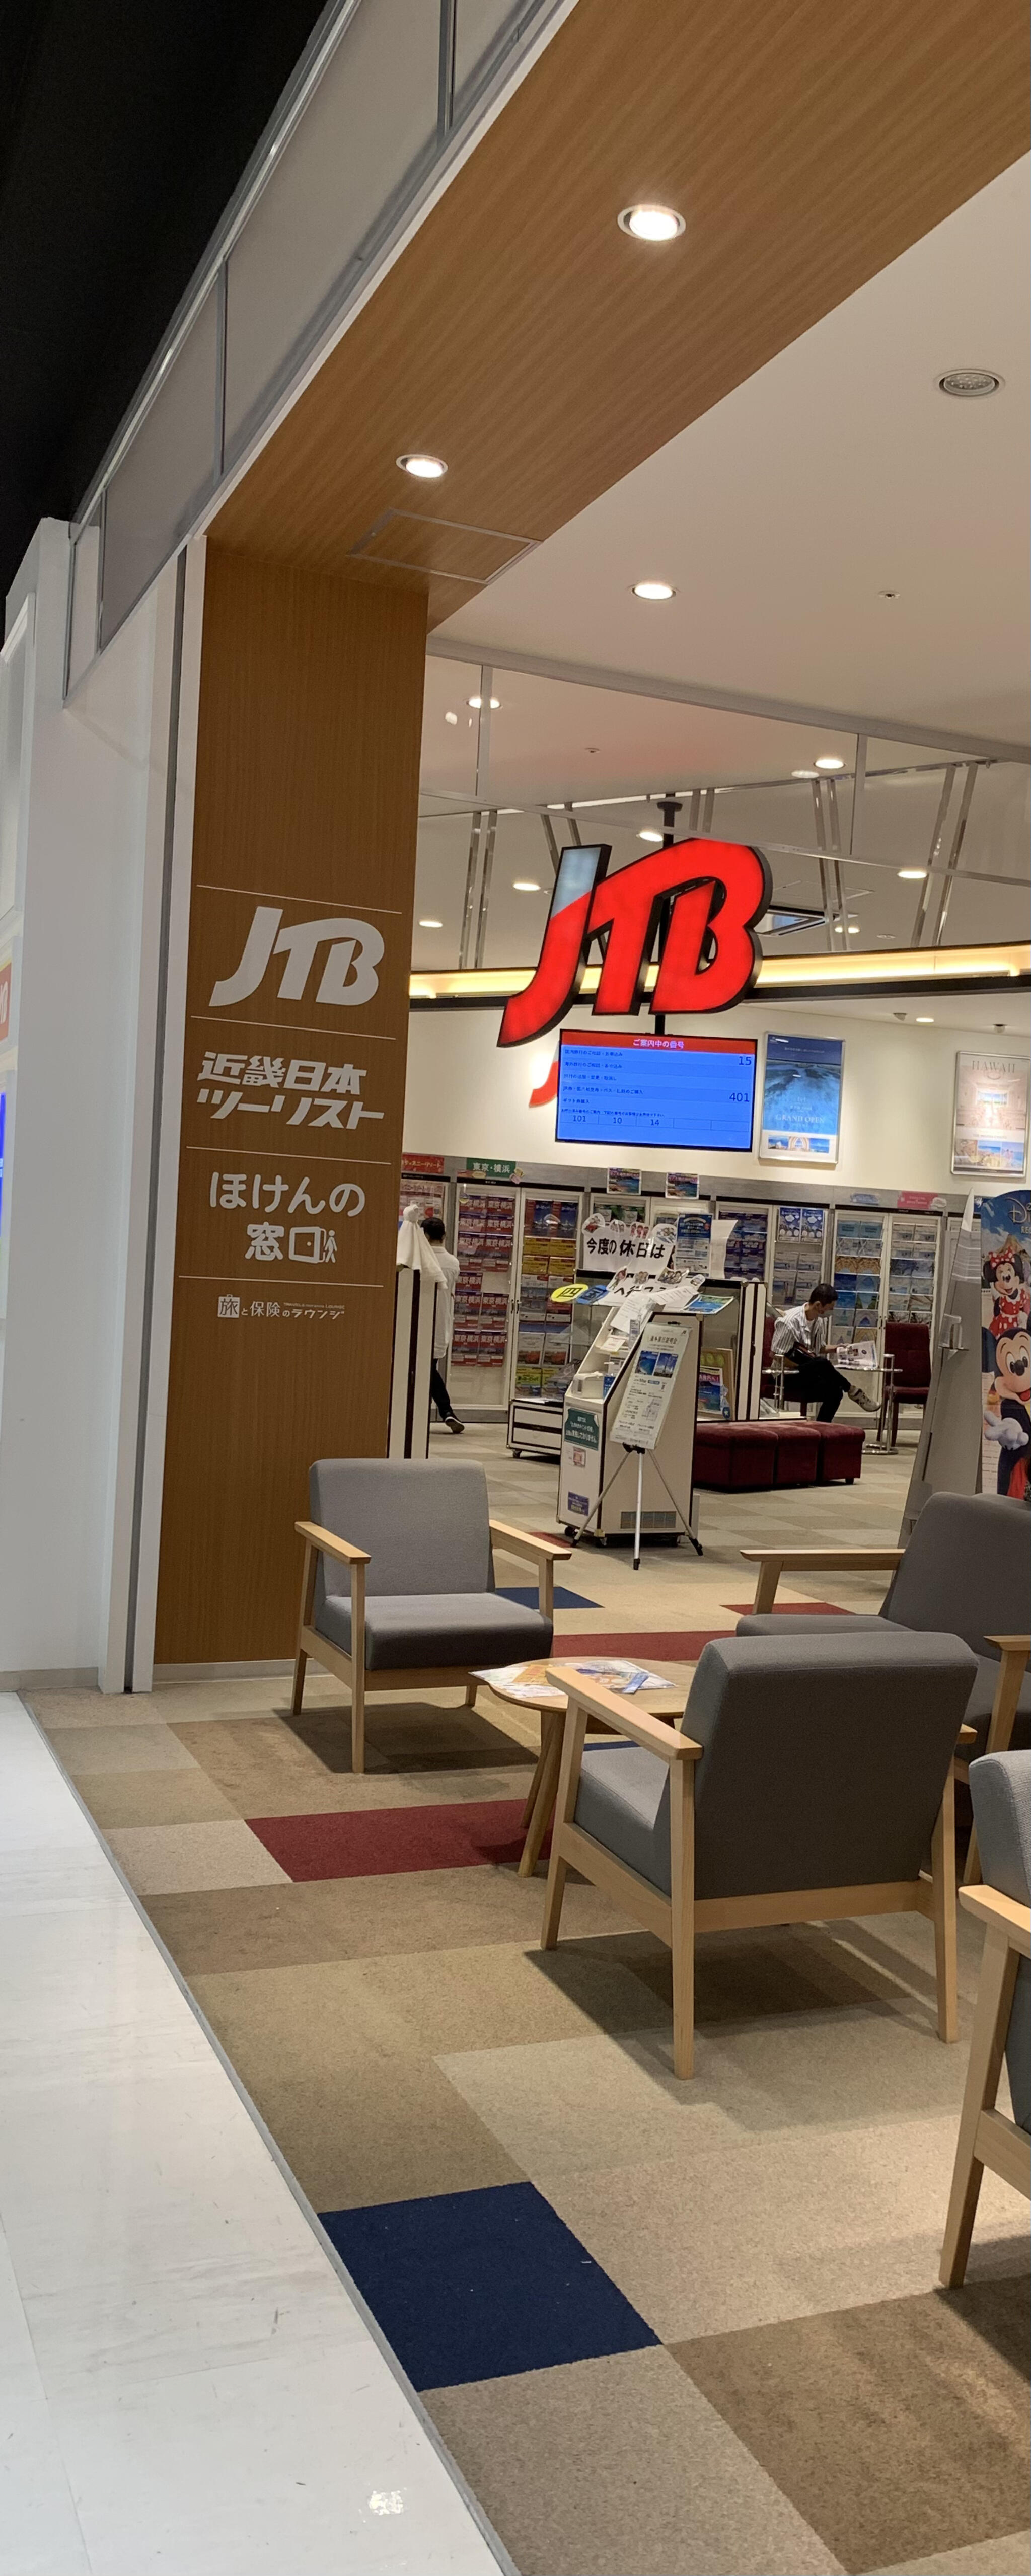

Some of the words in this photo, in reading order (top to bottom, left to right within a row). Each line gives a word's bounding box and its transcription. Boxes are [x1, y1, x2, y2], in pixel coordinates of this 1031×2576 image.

[497, 837, 773, 1048] JTB
[208, 906, 385, 1007] JTB
[633, 1039, 684, 1049] ご案内中の番号
[738, 1056, 752, 1066] 15
[972, 1060, 1015, 1073] HAWAII
[197, 1052, 367, 1095] 近畿日本
[197, 1089, 385, 1129] ツーリスト
[729, 1092, 750, 1103] 401
[473, 1162, 511, 1173] 東京・横浜
[209, 1172, 366, 1217] ほけんの
[245, 1222, 322, 1264] 窓口
[586, 1238, 665, 1259] 今度の休日は
[218, 1296, 345, 1319] 旅と保険のラウンジ
